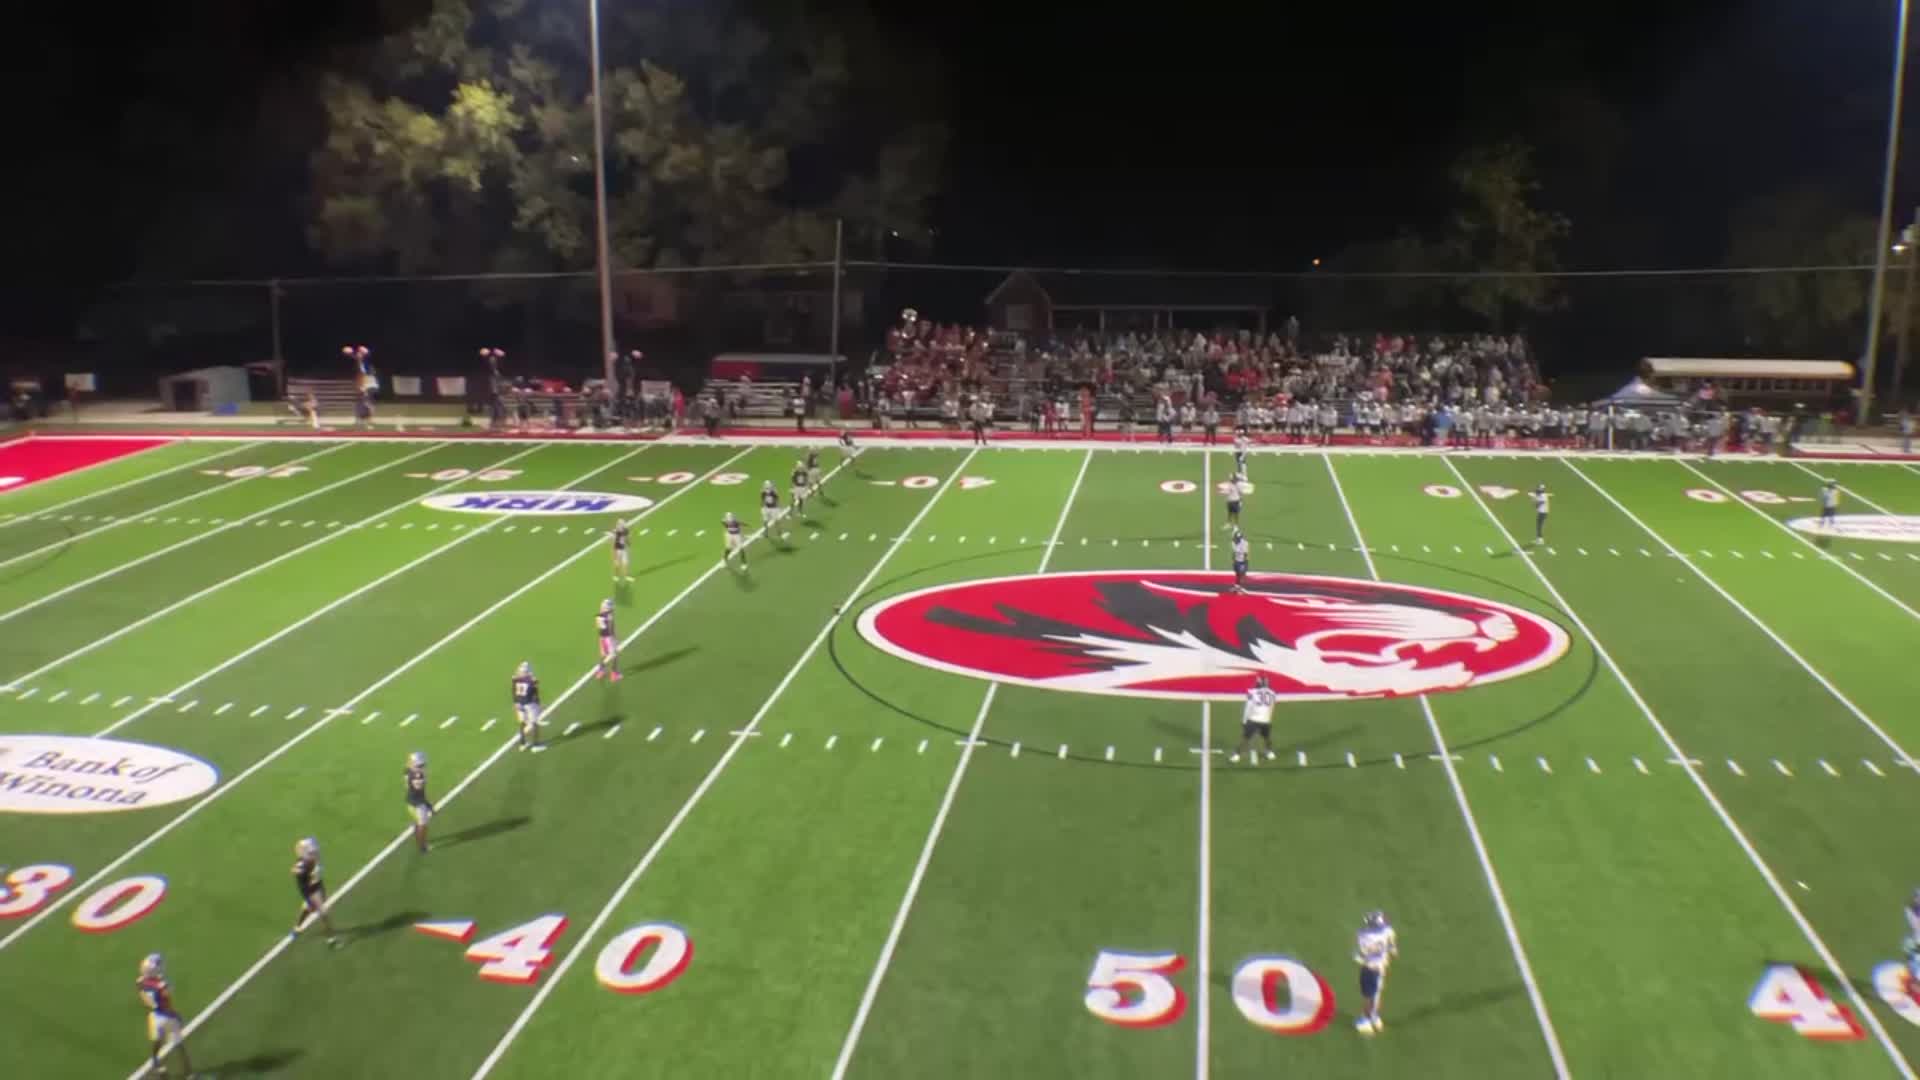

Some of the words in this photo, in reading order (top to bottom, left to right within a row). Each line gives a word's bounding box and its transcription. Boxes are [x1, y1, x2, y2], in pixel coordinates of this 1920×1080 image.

[451, 496, 617, 512] KIRK
[23, 751, 134, 777] Bank
[130, 762, 192, 784] of
